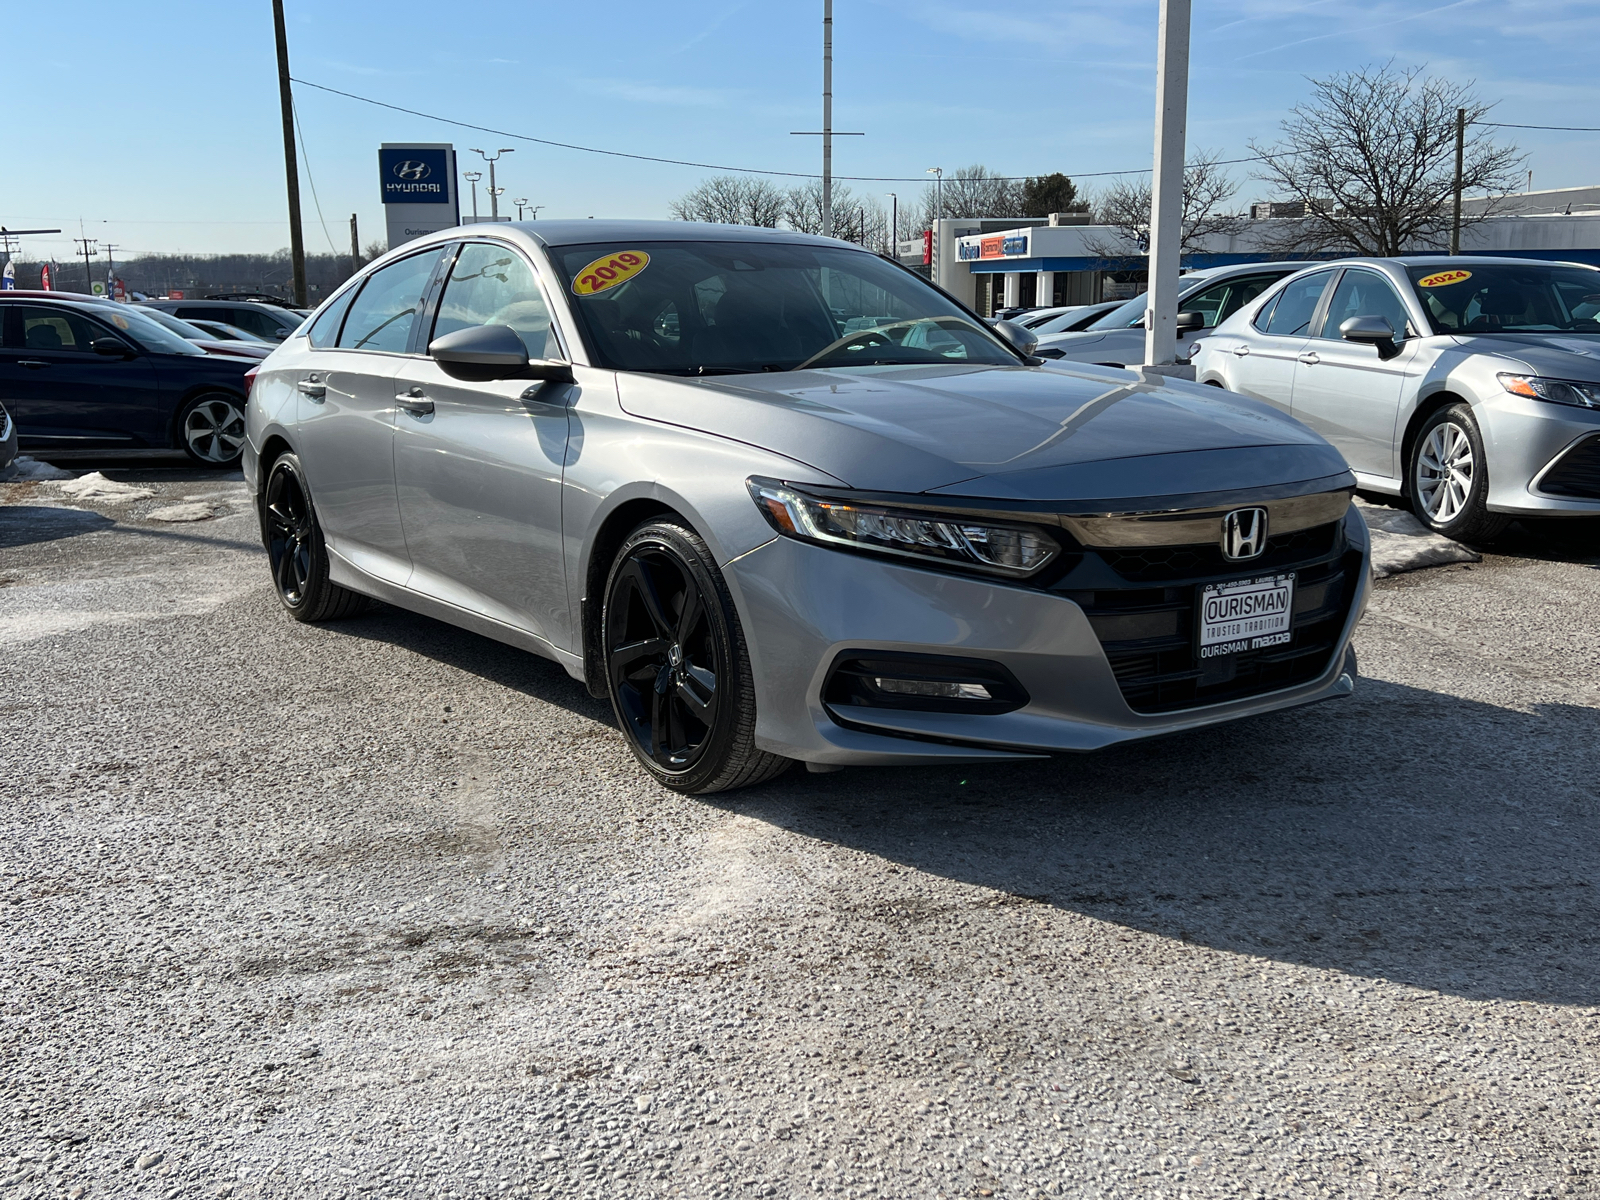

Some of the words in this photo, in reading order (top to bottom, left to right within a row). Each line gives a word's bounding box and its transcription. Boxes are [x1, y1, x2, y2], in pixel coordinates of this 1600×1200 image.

[386, 183, 440, 192] HYUNDAI
[581, 253, 642, 291] 2019
[1424, 271, 1467, 286] 2024
[1208, 591, 1285, 619] OURISMAN
[1207, 624, 1240, 638] TRUSTED
[1245, 617, 1284, 632] TRADITION
[1201, 641, 1248, 658] OURISMAN
